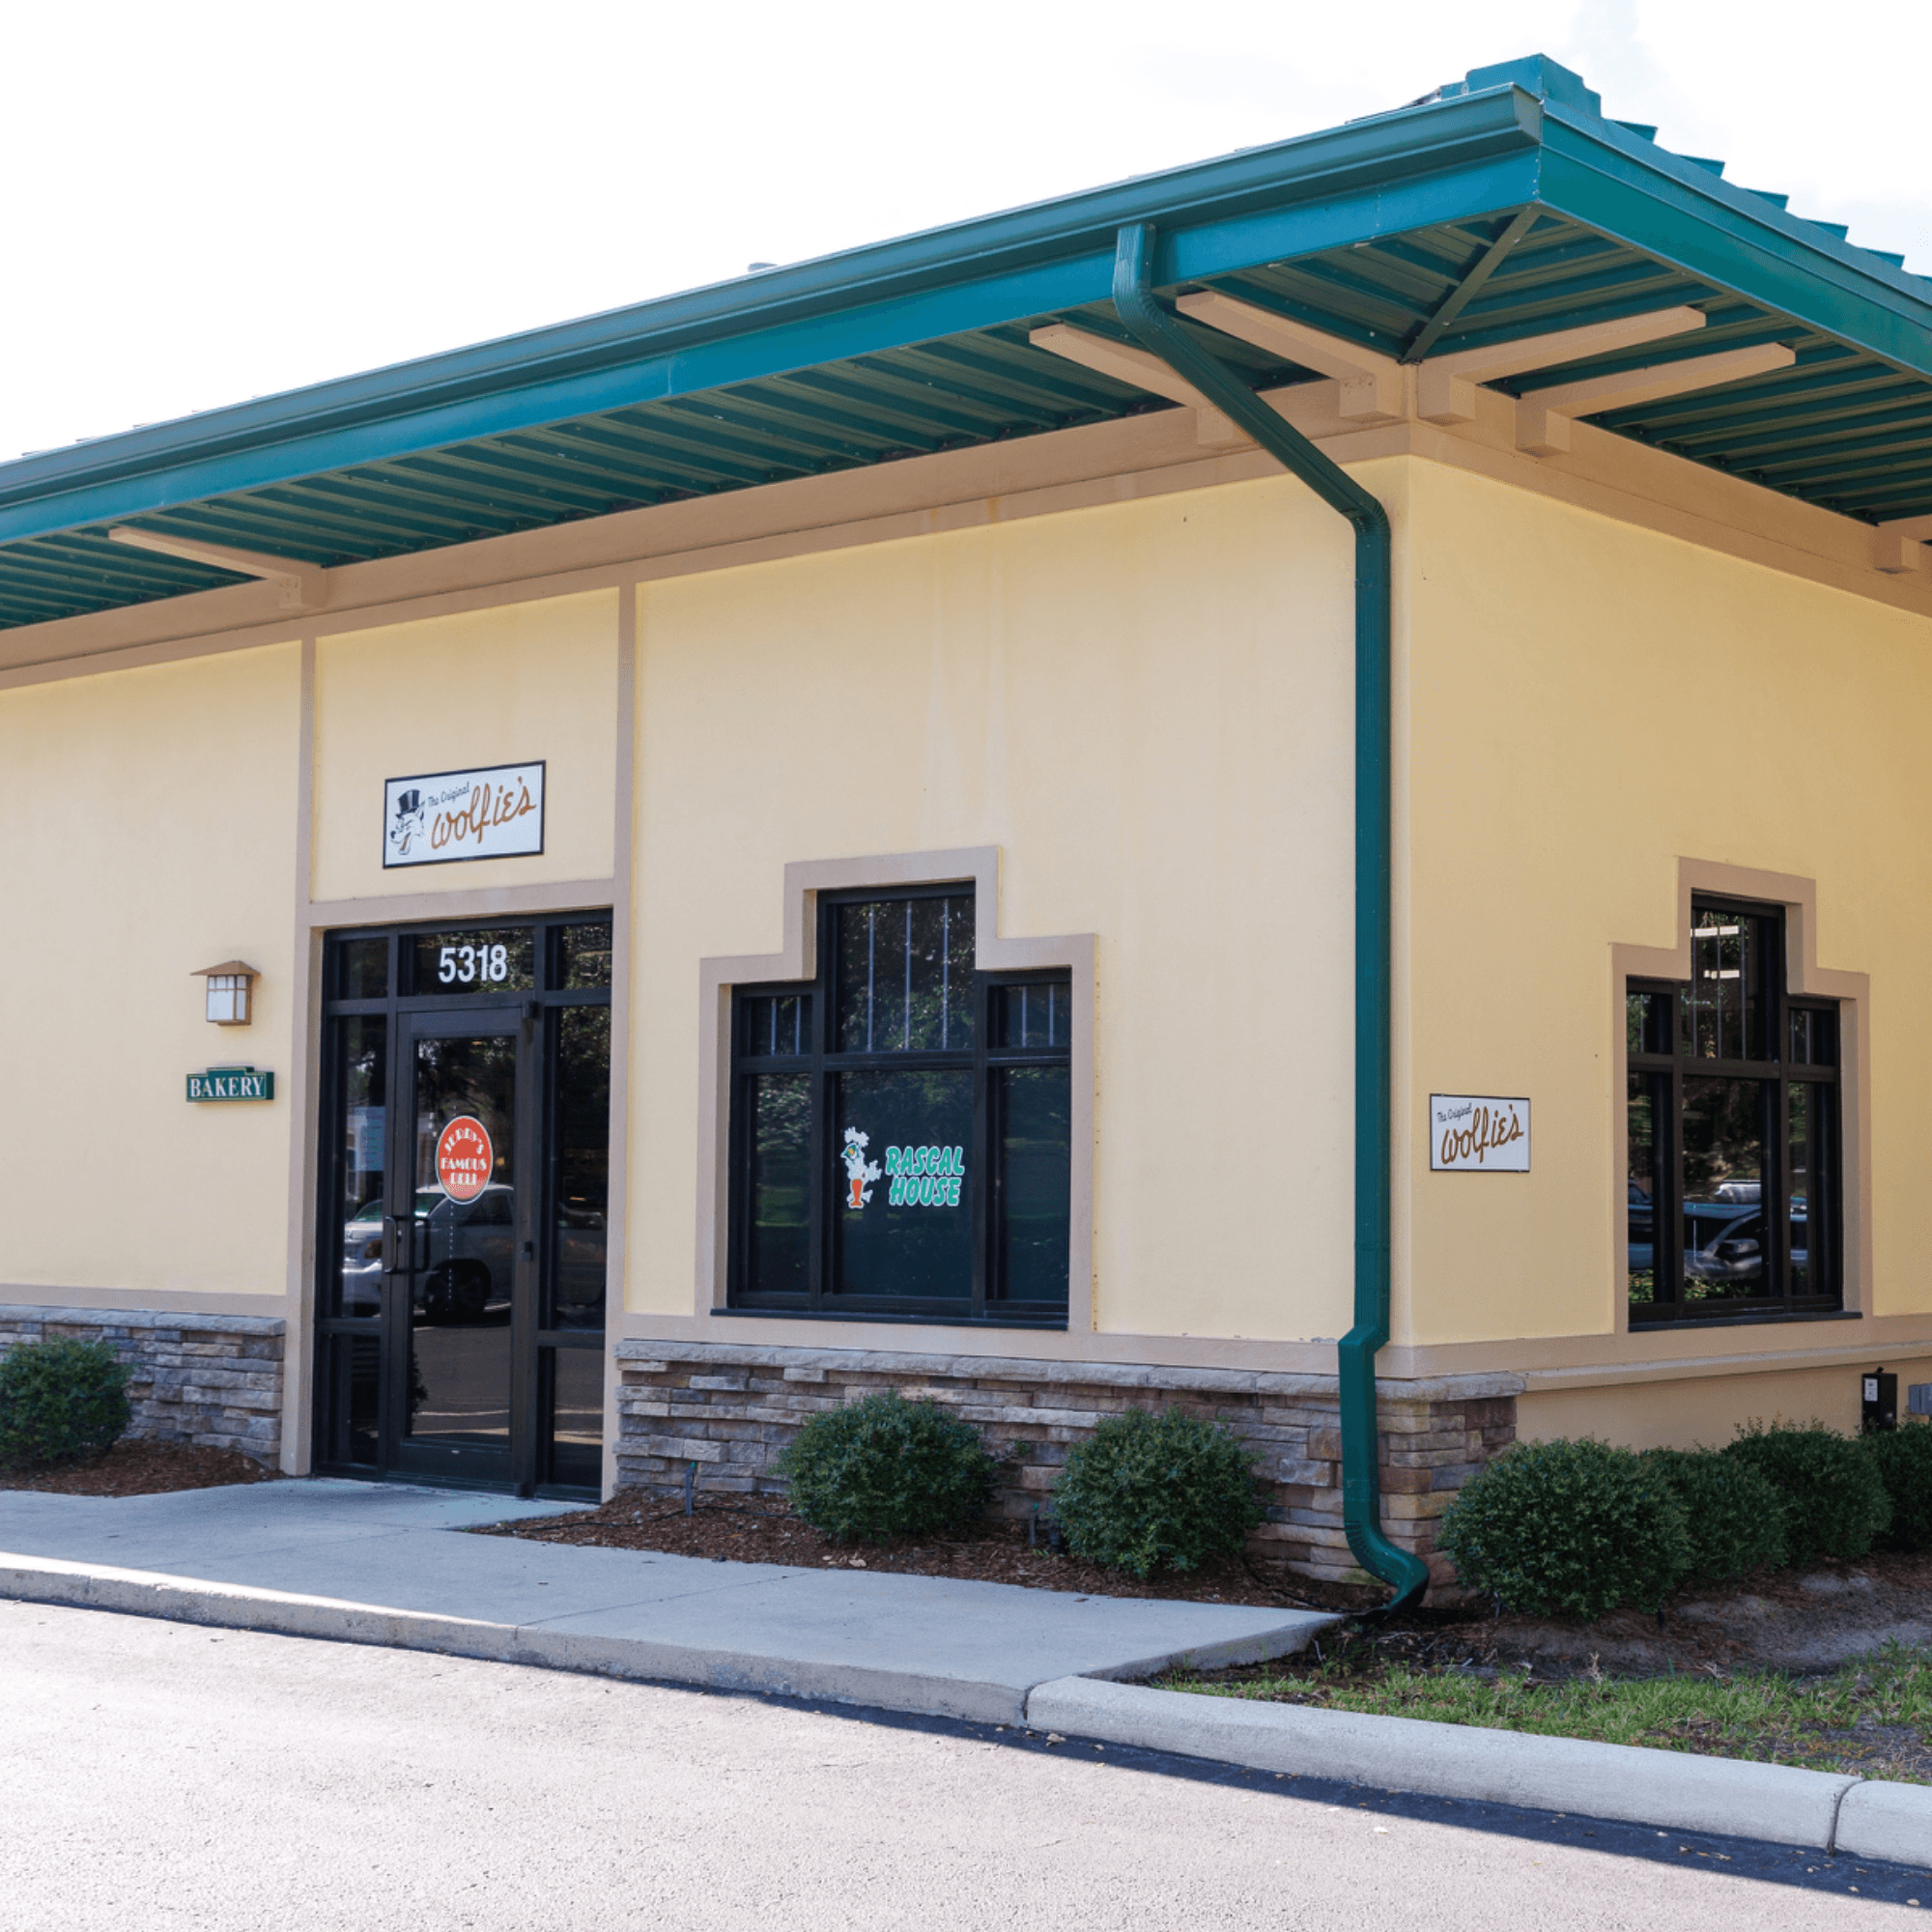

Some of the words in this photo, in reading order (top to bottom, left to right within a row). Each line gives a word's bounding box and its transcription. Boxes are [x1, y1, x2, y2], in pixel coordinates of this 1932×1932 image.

[428, 796, 439, 807] The
[440, 781, 470, 803] Original
[438, 944, 507, 983] 5318
[189, 1076, 265, 1097] BAKERY
[440, 1156, 488, 1172] FAMOUS
[885, 1146, 965, 1176] RASCAL
[449, 1171, 477, 1187] DELI
[889, 1177, 961, 1207] HOUSE
